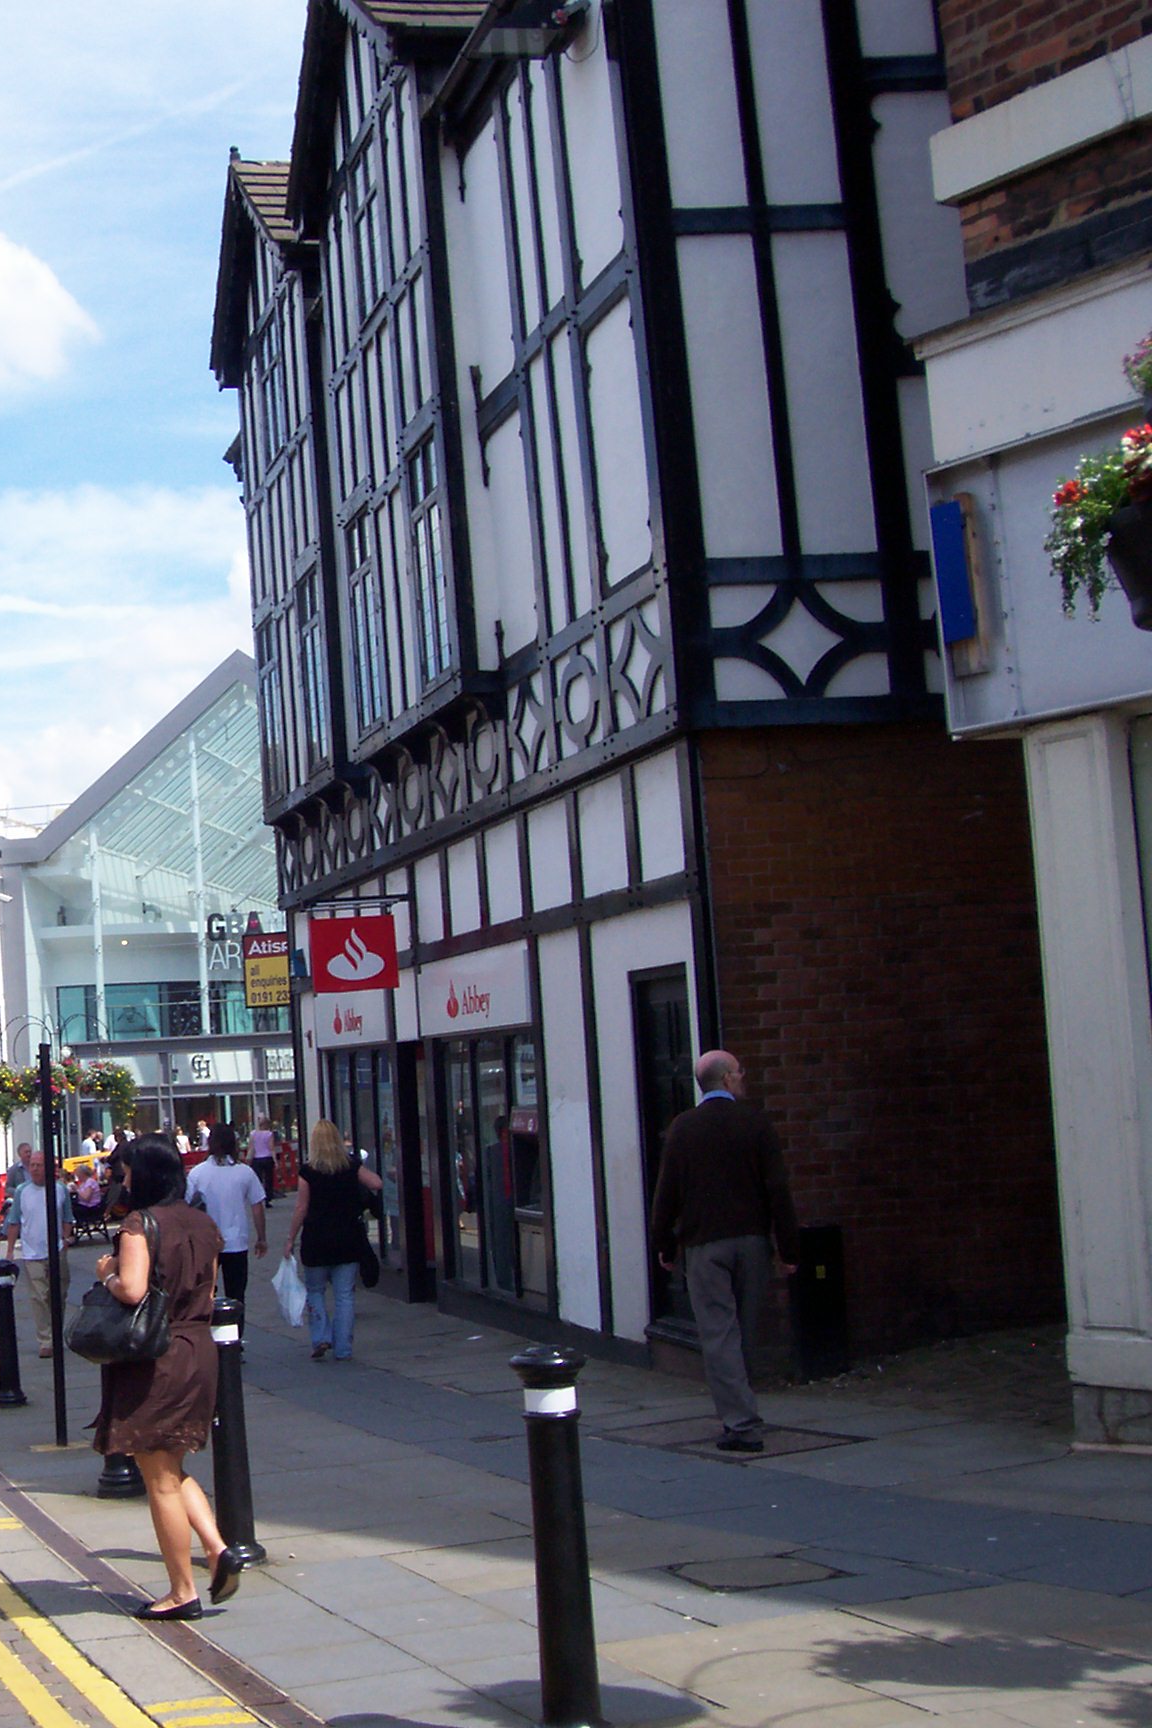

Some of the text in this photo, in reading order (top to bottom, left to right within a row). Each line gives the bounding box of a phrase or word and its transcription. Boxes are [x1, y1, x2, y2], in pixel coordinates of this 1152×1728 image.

[250, 964, 260, 976] all
[251, 974, 287, 989] enquiries
[250, 990, 273, 1004] 0191
[461, 984, 491, 1018] Abbey
[344, 1007, 363, 1036] Abbey
